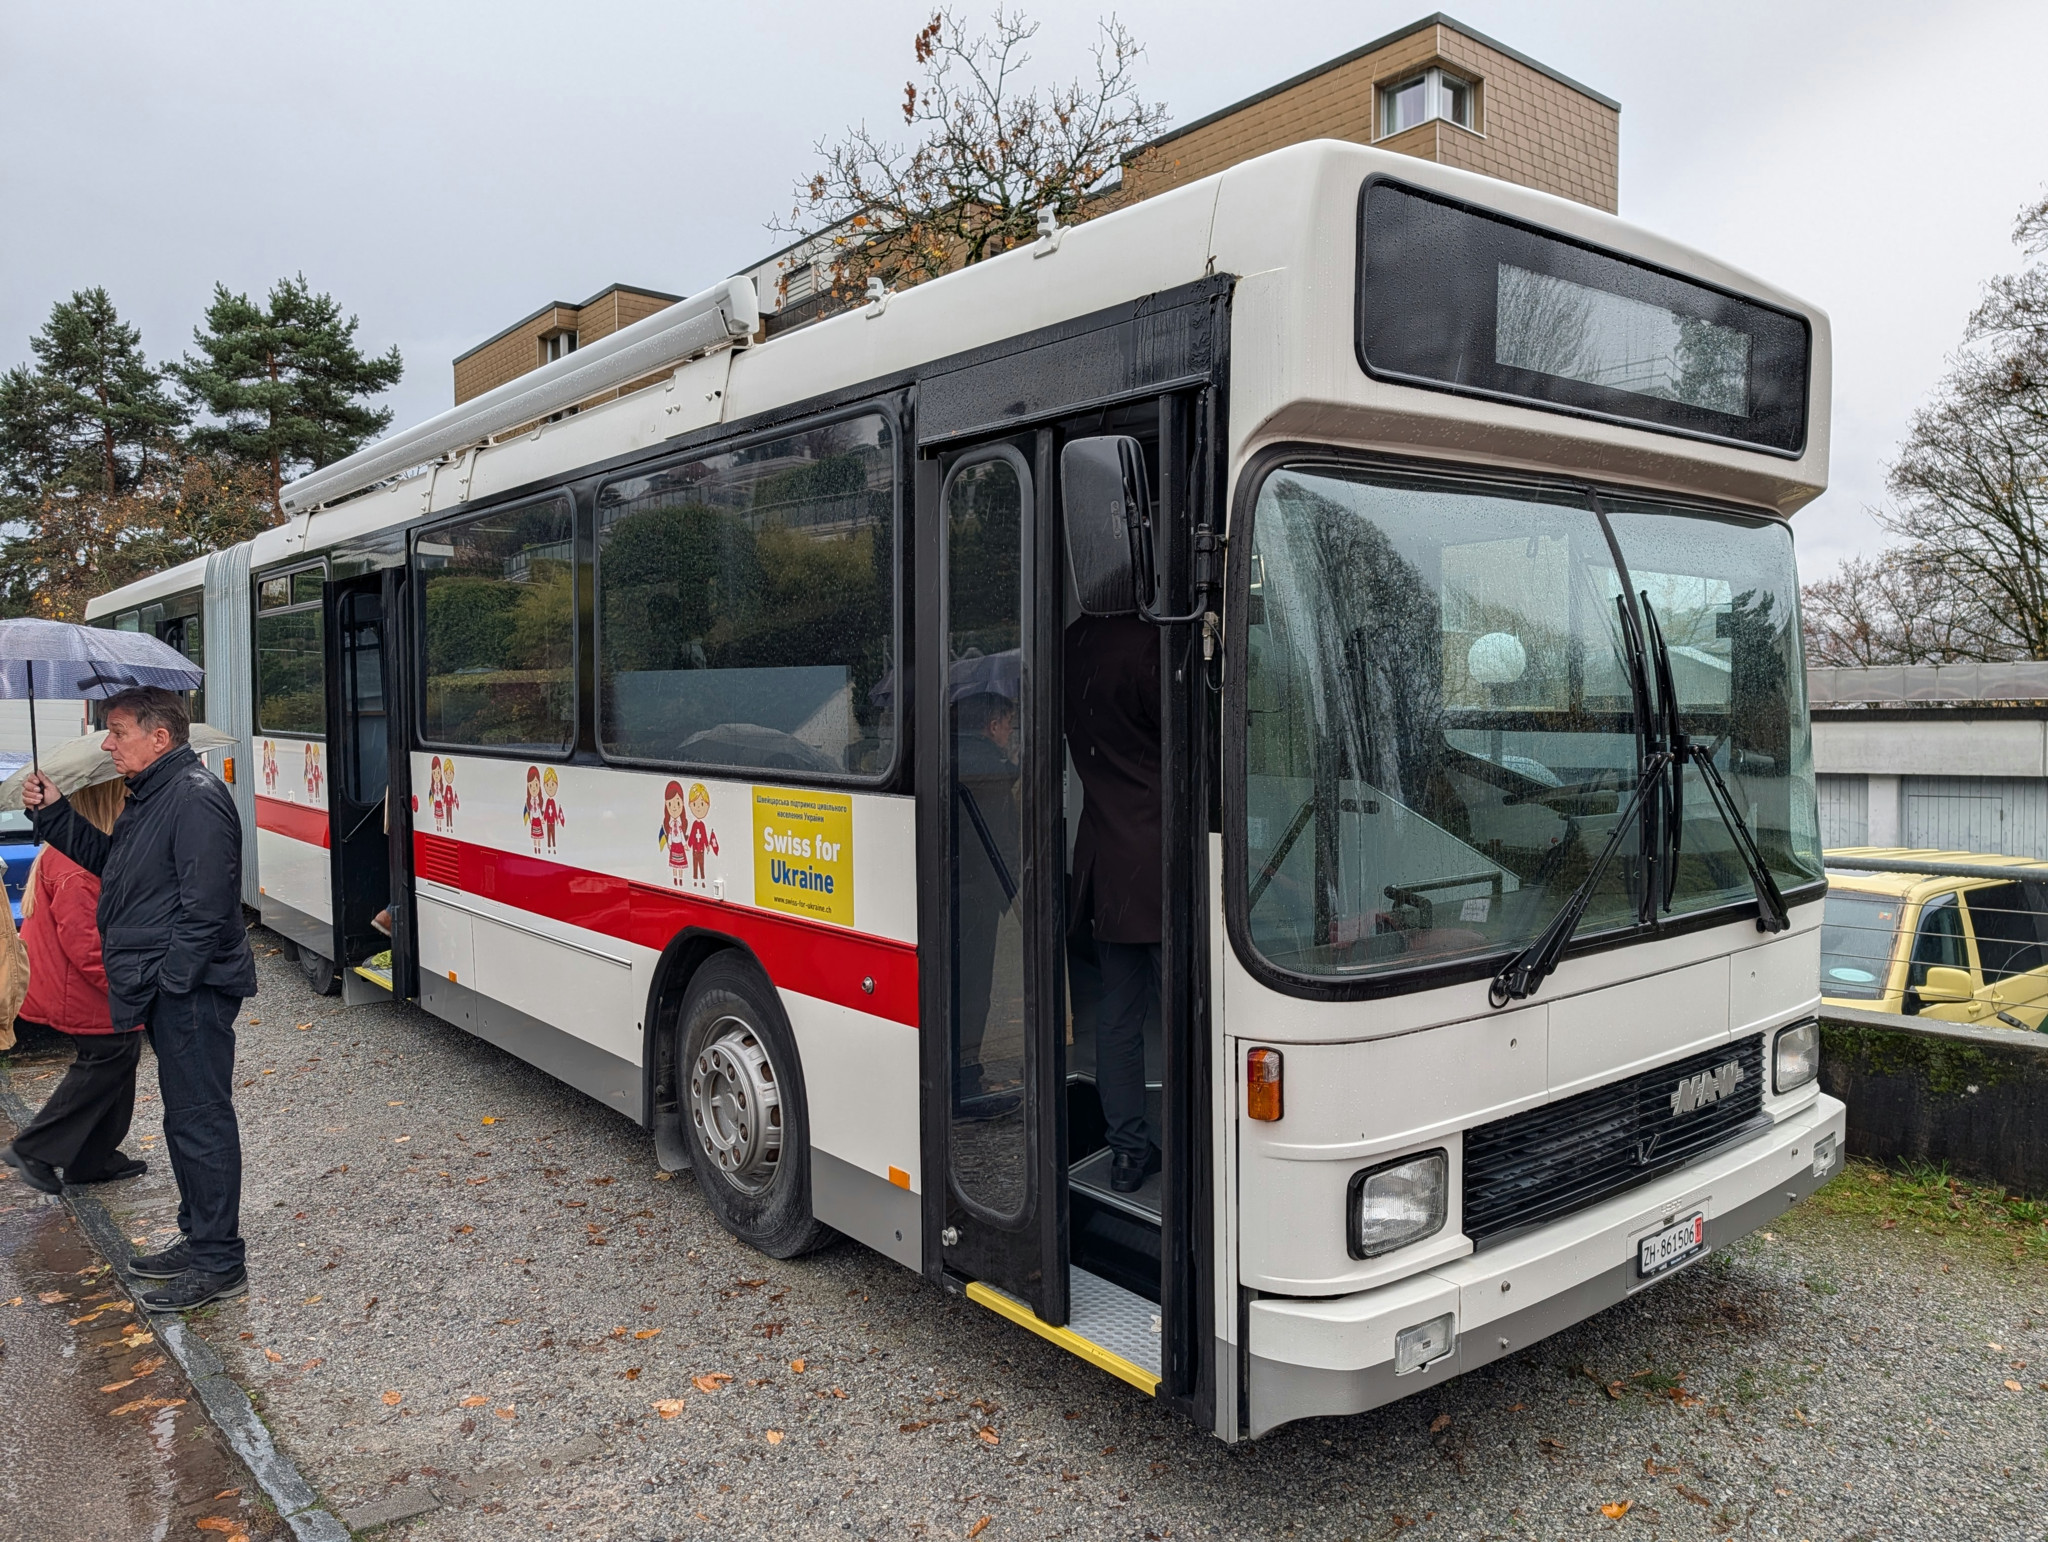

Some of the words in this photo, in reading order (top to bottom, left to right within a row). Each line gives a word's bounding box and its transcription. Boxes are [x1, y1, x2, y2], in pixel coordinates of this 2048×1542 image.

[804, 812, 825, 823] України
[763, 826, 812, 858] Swiss
[815, 833, 841, 862] for
[771, 858, 834, 894] Ukraine
[773, 895, 833, 914] www.swiss-for-ukraine.ch
